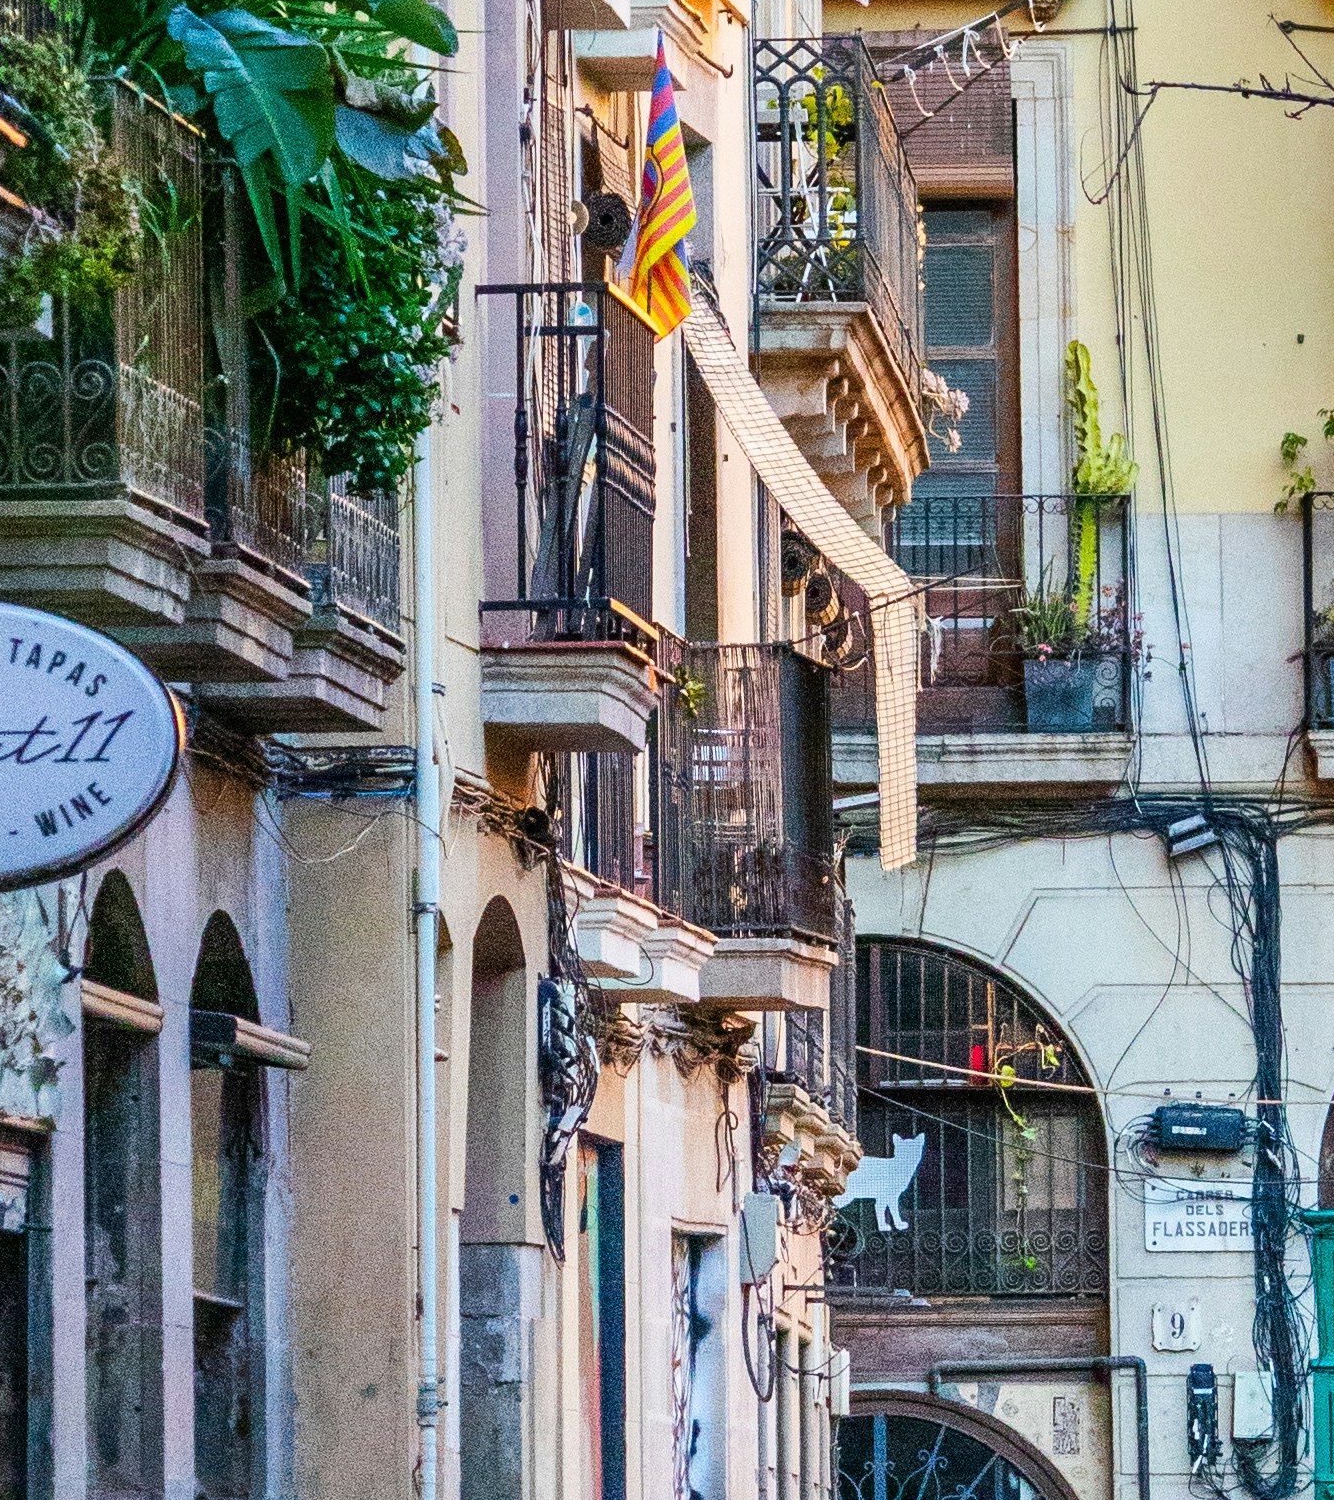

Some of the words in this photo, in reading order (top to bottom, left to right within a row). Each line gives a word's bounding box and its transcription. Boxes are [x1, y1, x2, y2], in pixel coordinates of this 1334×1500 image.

[9, 637, 109, 697] TAPAS
[33, 781, 113, 839] WINE
[1185, 1204, 1224, 1216] DELS
[1152, 1220, 1255, 1237] FLASSADER
[1170, 1312, 1185, 1339] 9
